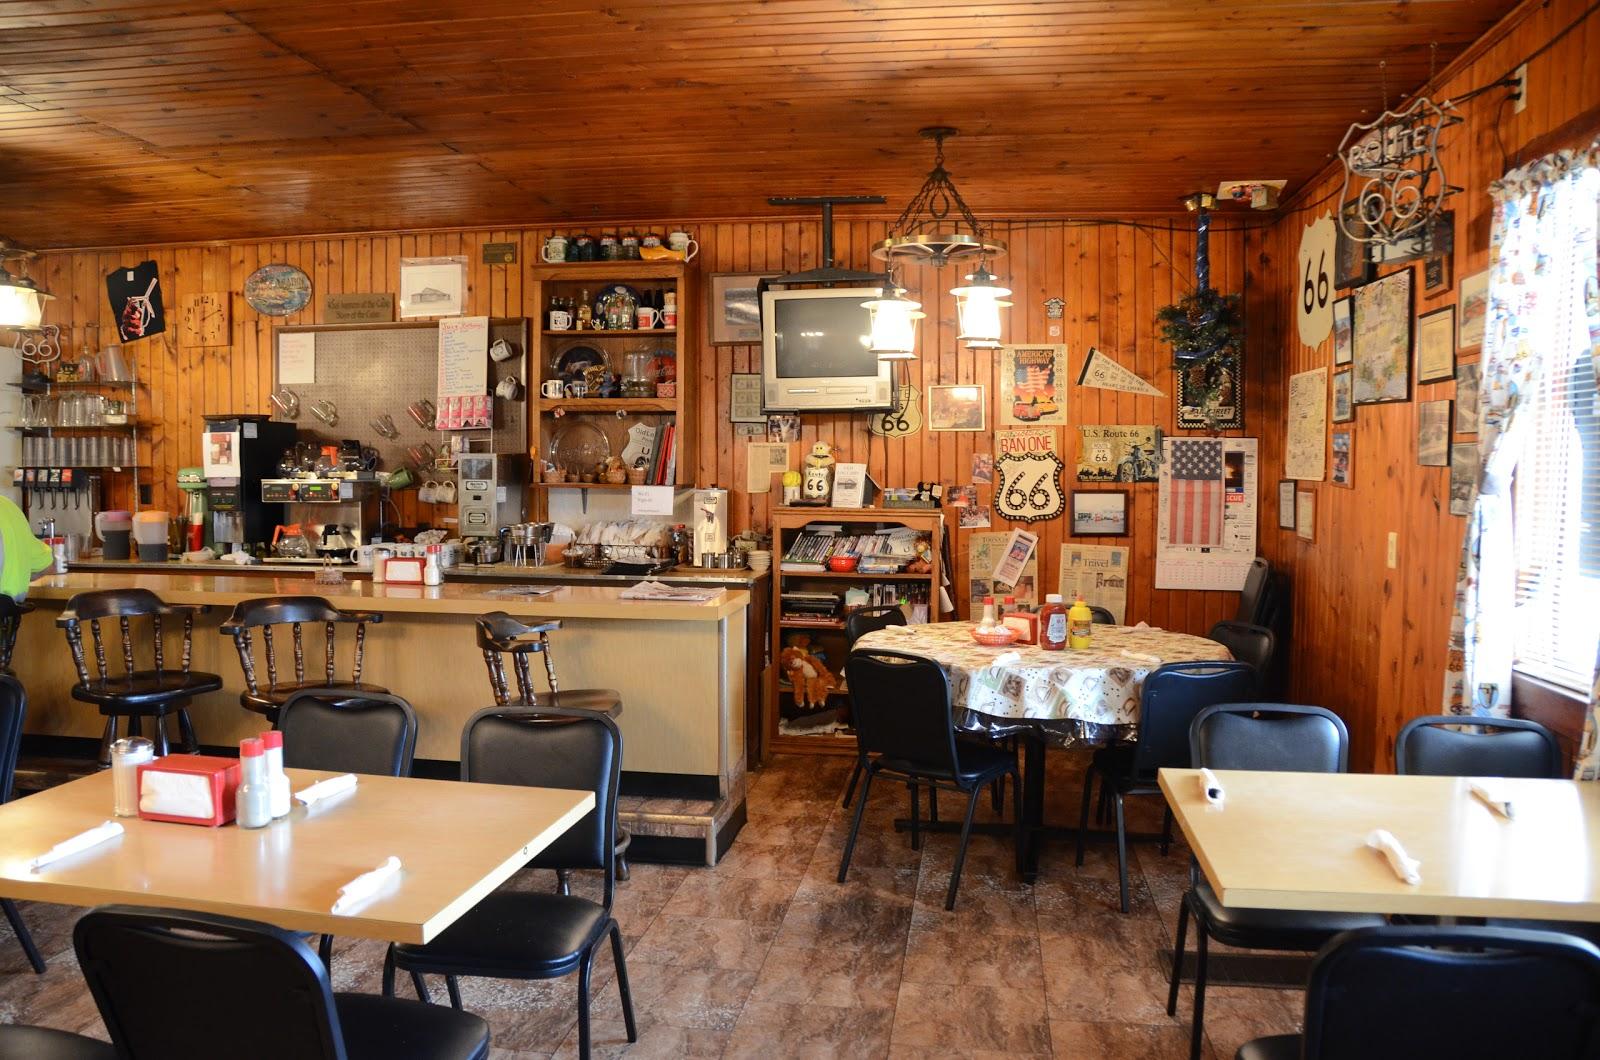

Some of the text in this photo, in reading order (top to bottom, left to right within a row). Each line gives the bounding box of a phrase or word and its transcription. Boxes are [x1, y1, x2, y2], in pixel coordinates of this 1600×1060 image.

[1349, 126, 1427, 164] ROUTE
[1359, 169, 1421, 225] 66
[1304, 248, 1329, 315] 66
[22, 338, 53, 357] 66
[1019, 357, 1051, 365] HIGHWAY
[1094, 369, 1105, 379] 66
[881, 415, 910, 431] 66
[1083, 429, 1140, 438] U.S. Route 66
[1001, 435, 1052, 453] BAN ONE
[1095, 454, 1108, 462] 66
[807, 478, 824, 491] 66
[1005, 471, 1050, 511] 66
[1083, 558, 1109, 569] Travel
